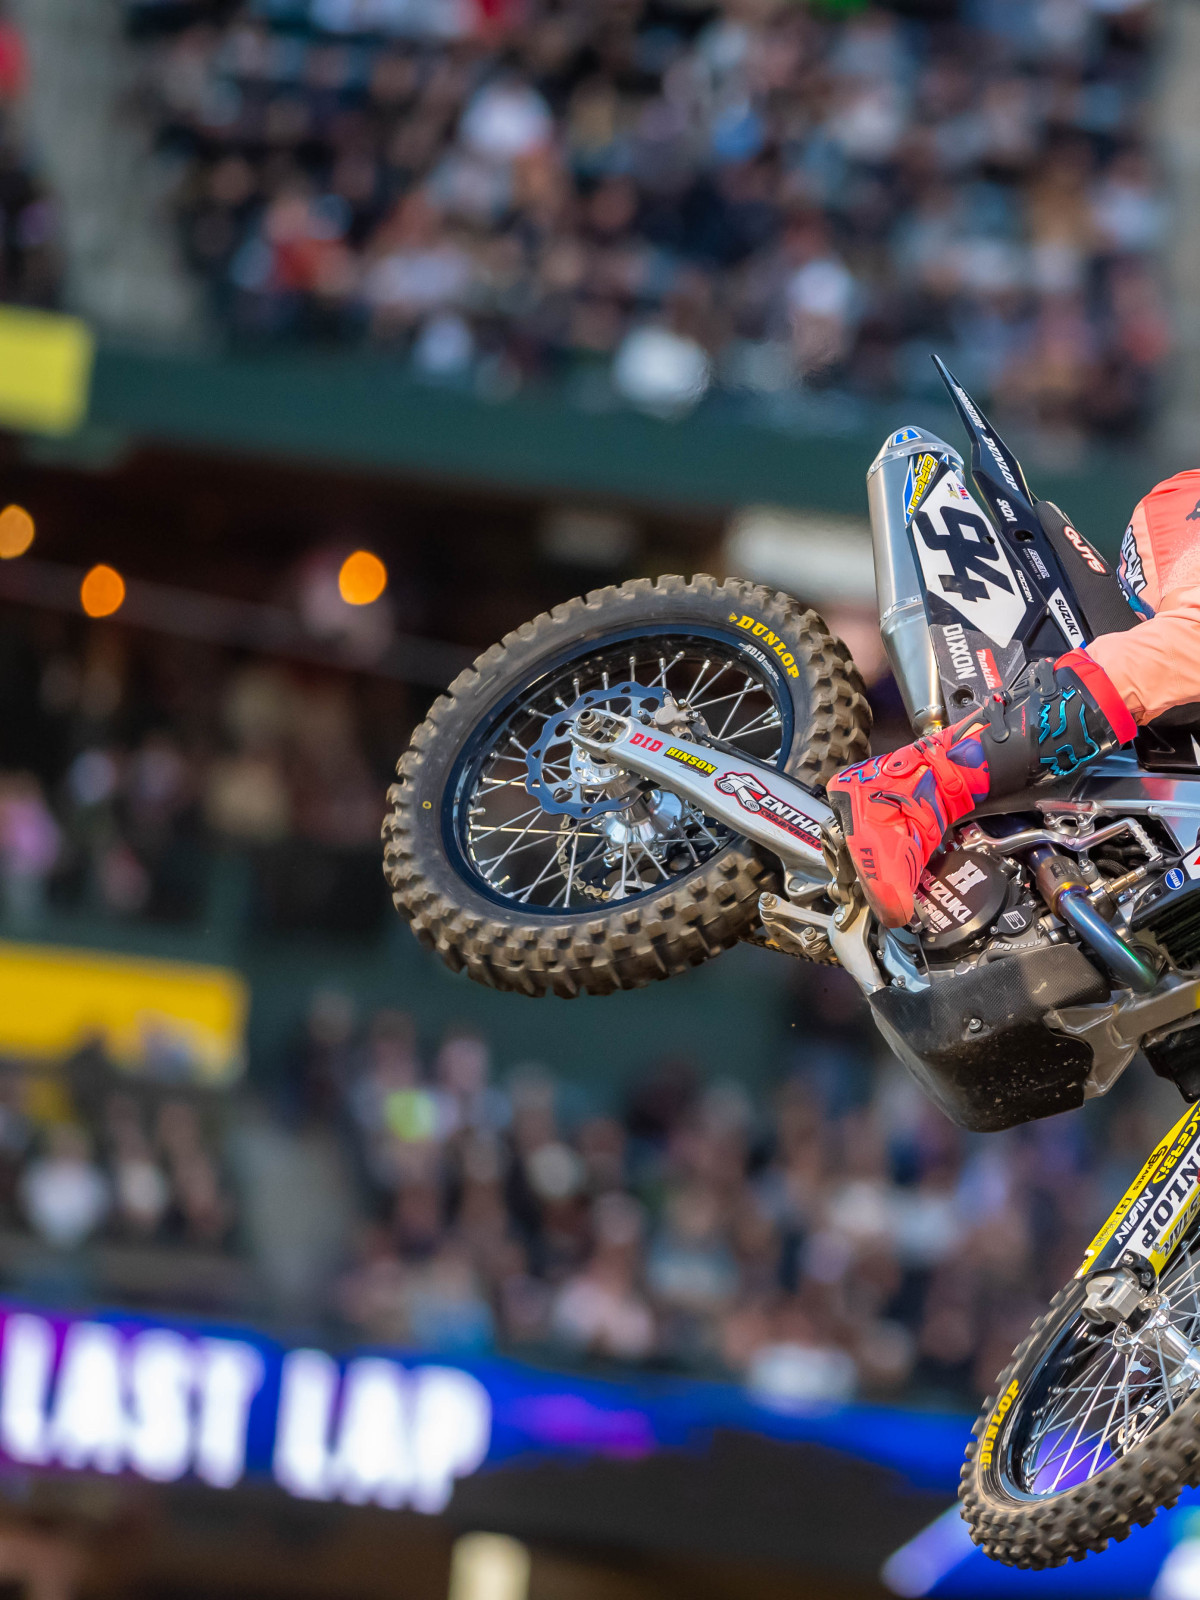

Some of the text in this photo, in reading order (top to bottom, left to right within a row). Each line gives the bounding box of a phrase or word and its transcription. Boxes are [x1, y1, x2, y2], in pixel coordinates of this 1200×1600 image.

[981, 434, 1020, 492] DUNLOP
[913, 506, 1016, 603] 94
[1063, 525, 1107, 574] GUTS
[1054, 598, 1079, 636] SUZUKI
[736, 615, 800, 679] DUNLOP
[942, 623, 977, 680] DIXXON
[976, 649, 997, 690] makita
[666, 747, 717, 774] HINSON
[859, 847, 878, 881] FOX
[2, 1312, 492, 1516] LAST LAP
